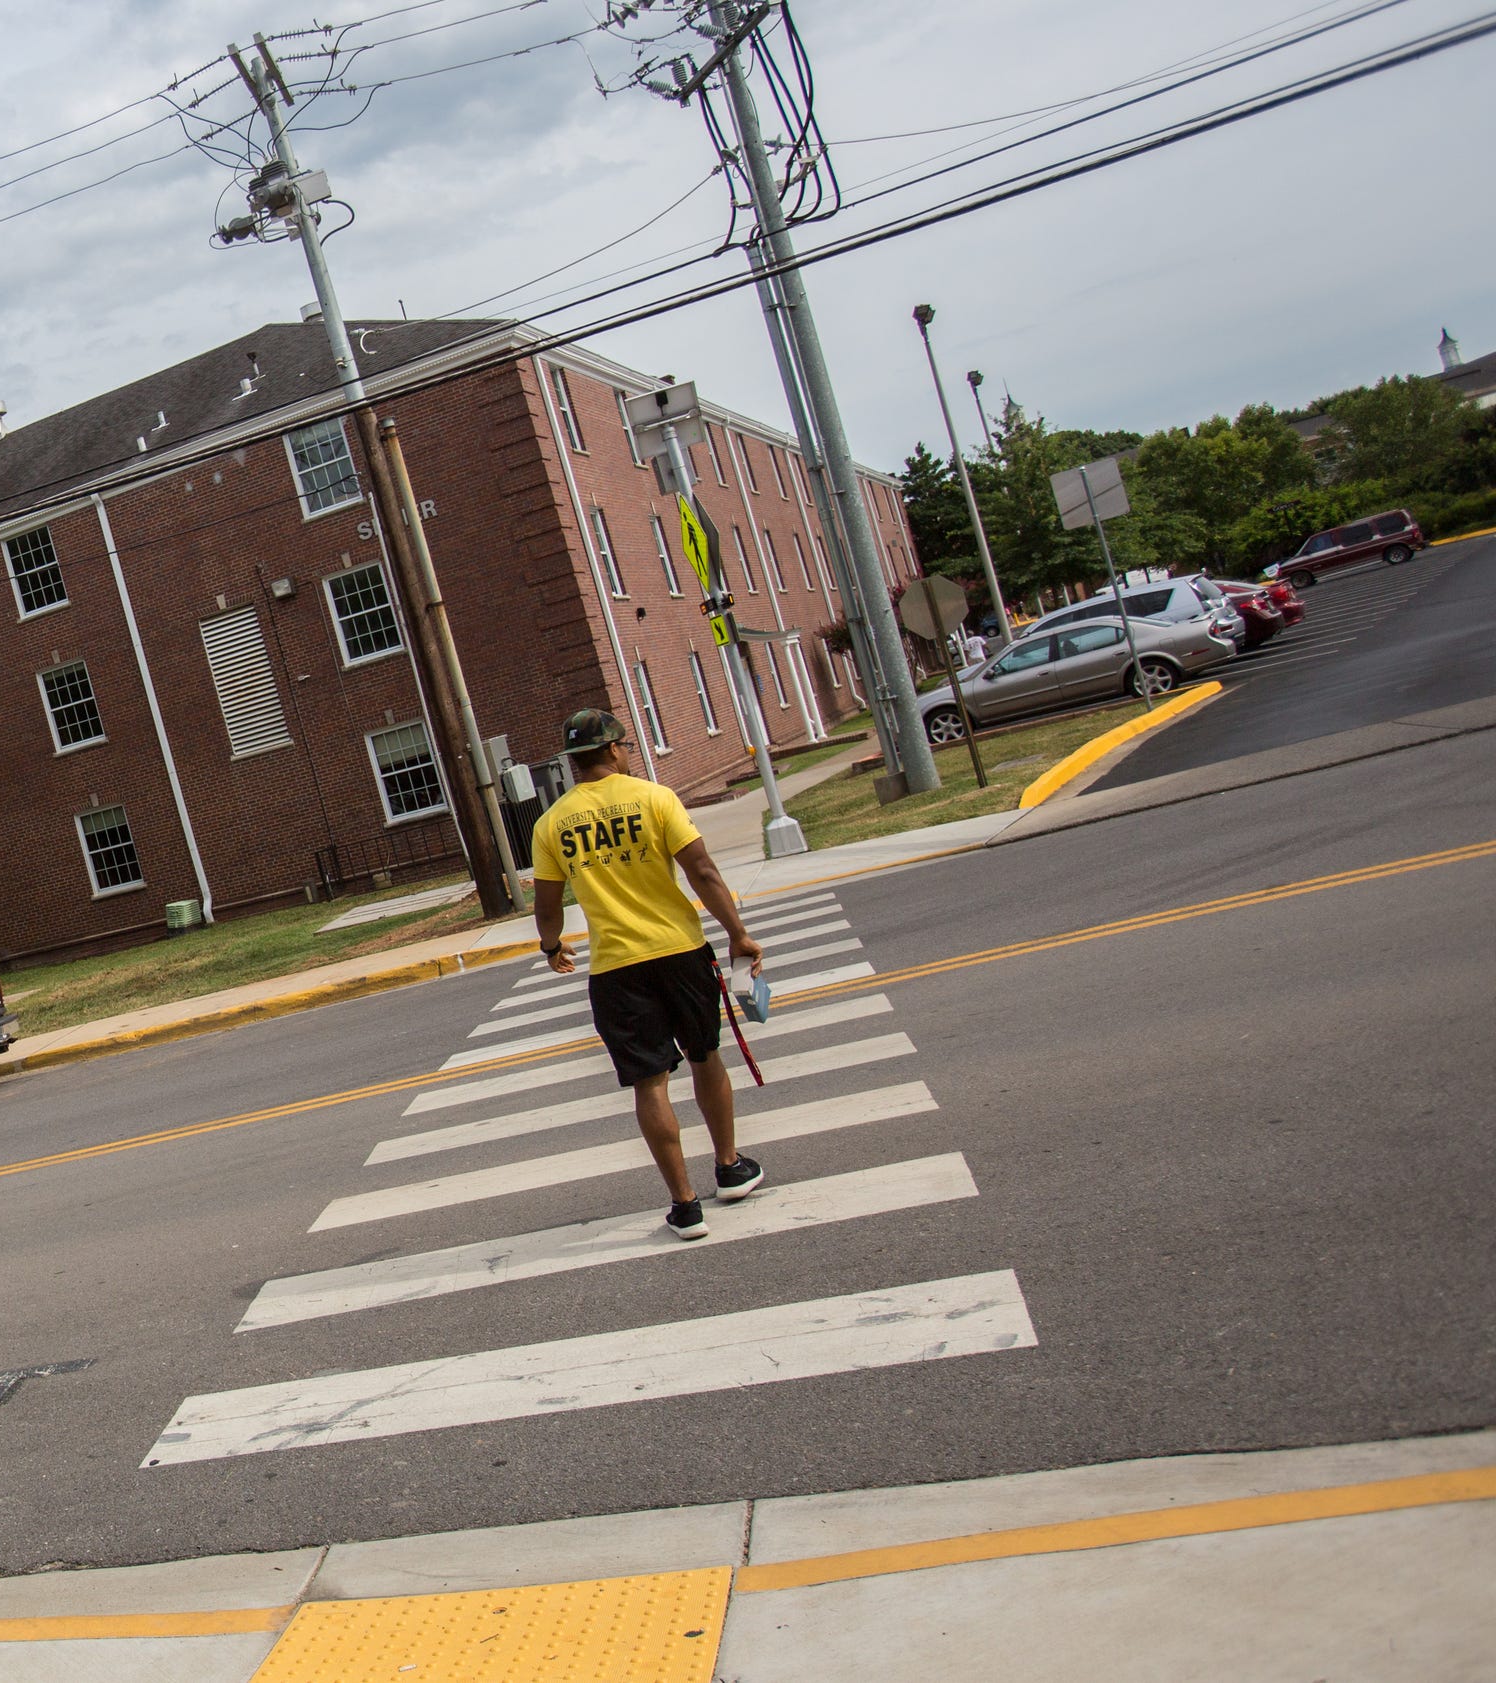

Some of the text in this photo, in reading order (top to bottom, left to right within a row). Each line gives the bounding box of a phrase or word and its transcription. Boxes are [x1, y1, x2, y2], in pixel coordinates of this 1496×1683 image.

[556, 801, 641, 831] UNIVERSITY RECREATION
[560, 813, 643, 858] STAFF
